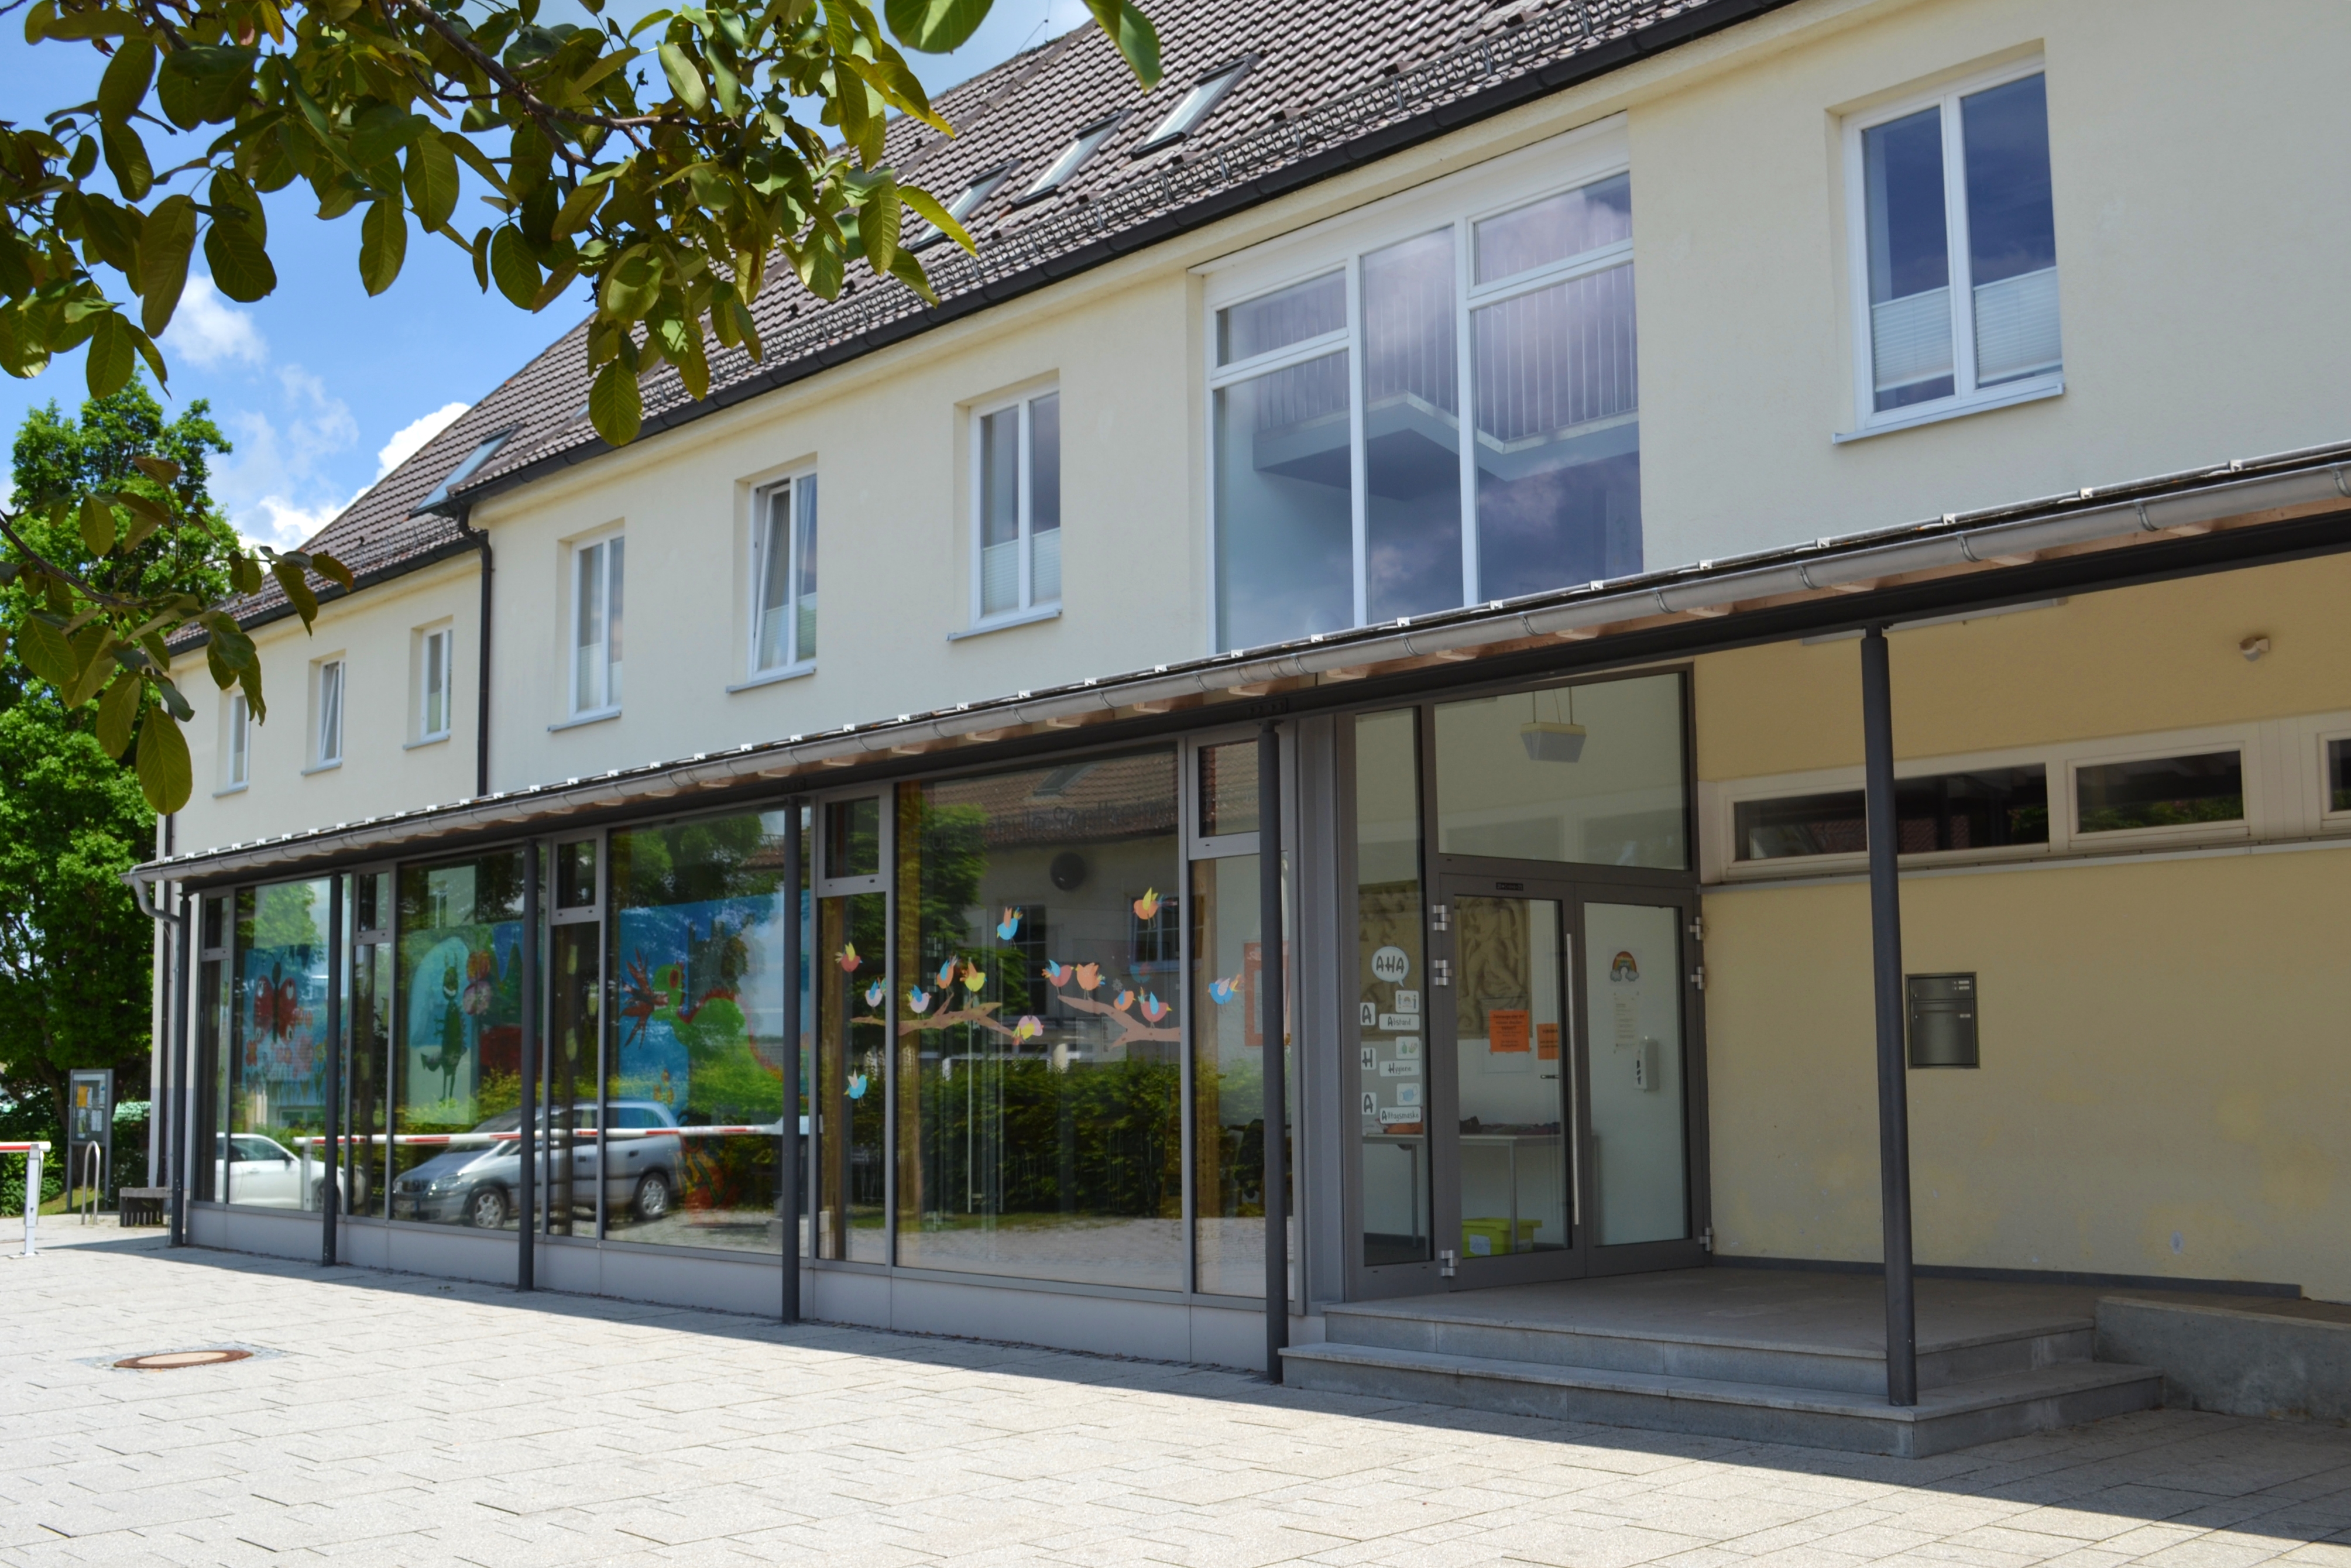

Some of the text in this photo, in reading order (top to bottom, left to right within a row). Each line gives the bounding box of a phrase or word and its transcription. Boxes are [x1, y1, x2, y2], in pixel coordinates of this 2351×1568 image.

[1376, 955, 1404, 974] AHA
[1361, 1004, 1372, 1024] A
[1388, 1015, 1411, 1027] Abstand
[1362, 1049, 1372, 1068] H
[1388, 1062, 1412, 1075] Hygiene
[1364, 1094, 1373, 1113] A
[1382, 1110, 1419, 1121] Alltagsmaske
